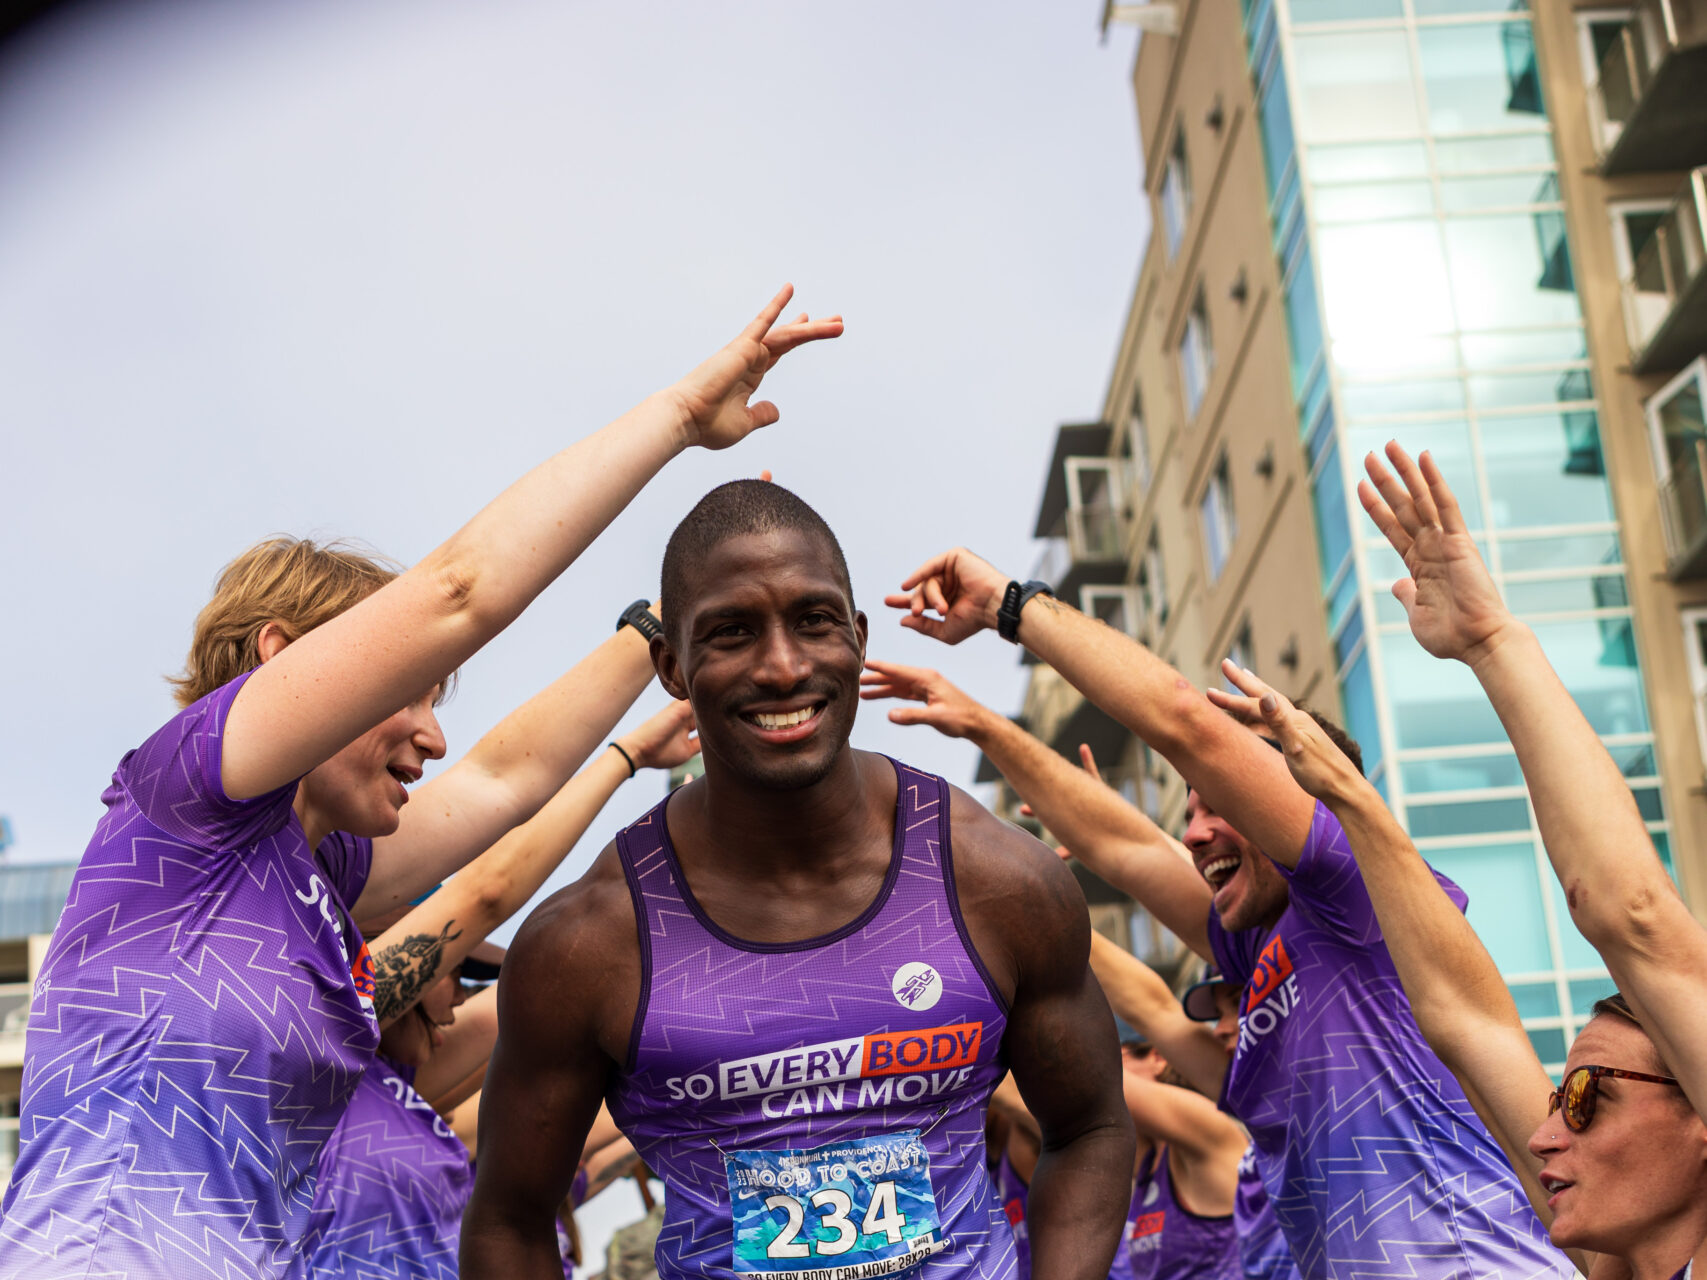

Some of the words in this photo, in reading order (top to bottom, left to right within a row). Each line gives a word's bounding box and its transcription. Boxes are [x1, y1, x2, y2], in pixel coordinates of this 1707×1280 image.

[1252, 942, 1282, 995] DY
[1237, 972, 1300, 1060] MOVE
[666, 1073, 714, 1101] SO
[727, 1044, 860, 1093] EVERY
[868, 1028, 979, 1072] BODY
[761, 1082, 845, 1118] CAN
[857, 1065, 974, 1108] MOVE
[745, 1166, 811, 1188] HOOD
[817, 1163, 848, 1183] TO
[856, 1148, 921, 1179] COAST
[831, 1144, 886, 1158] PROVIDENCE
[765, 1180, 907, 1259] 234
[837, 1266, 860, 1280] CAN
[863, 1260, 896, 1276] MOVE:
